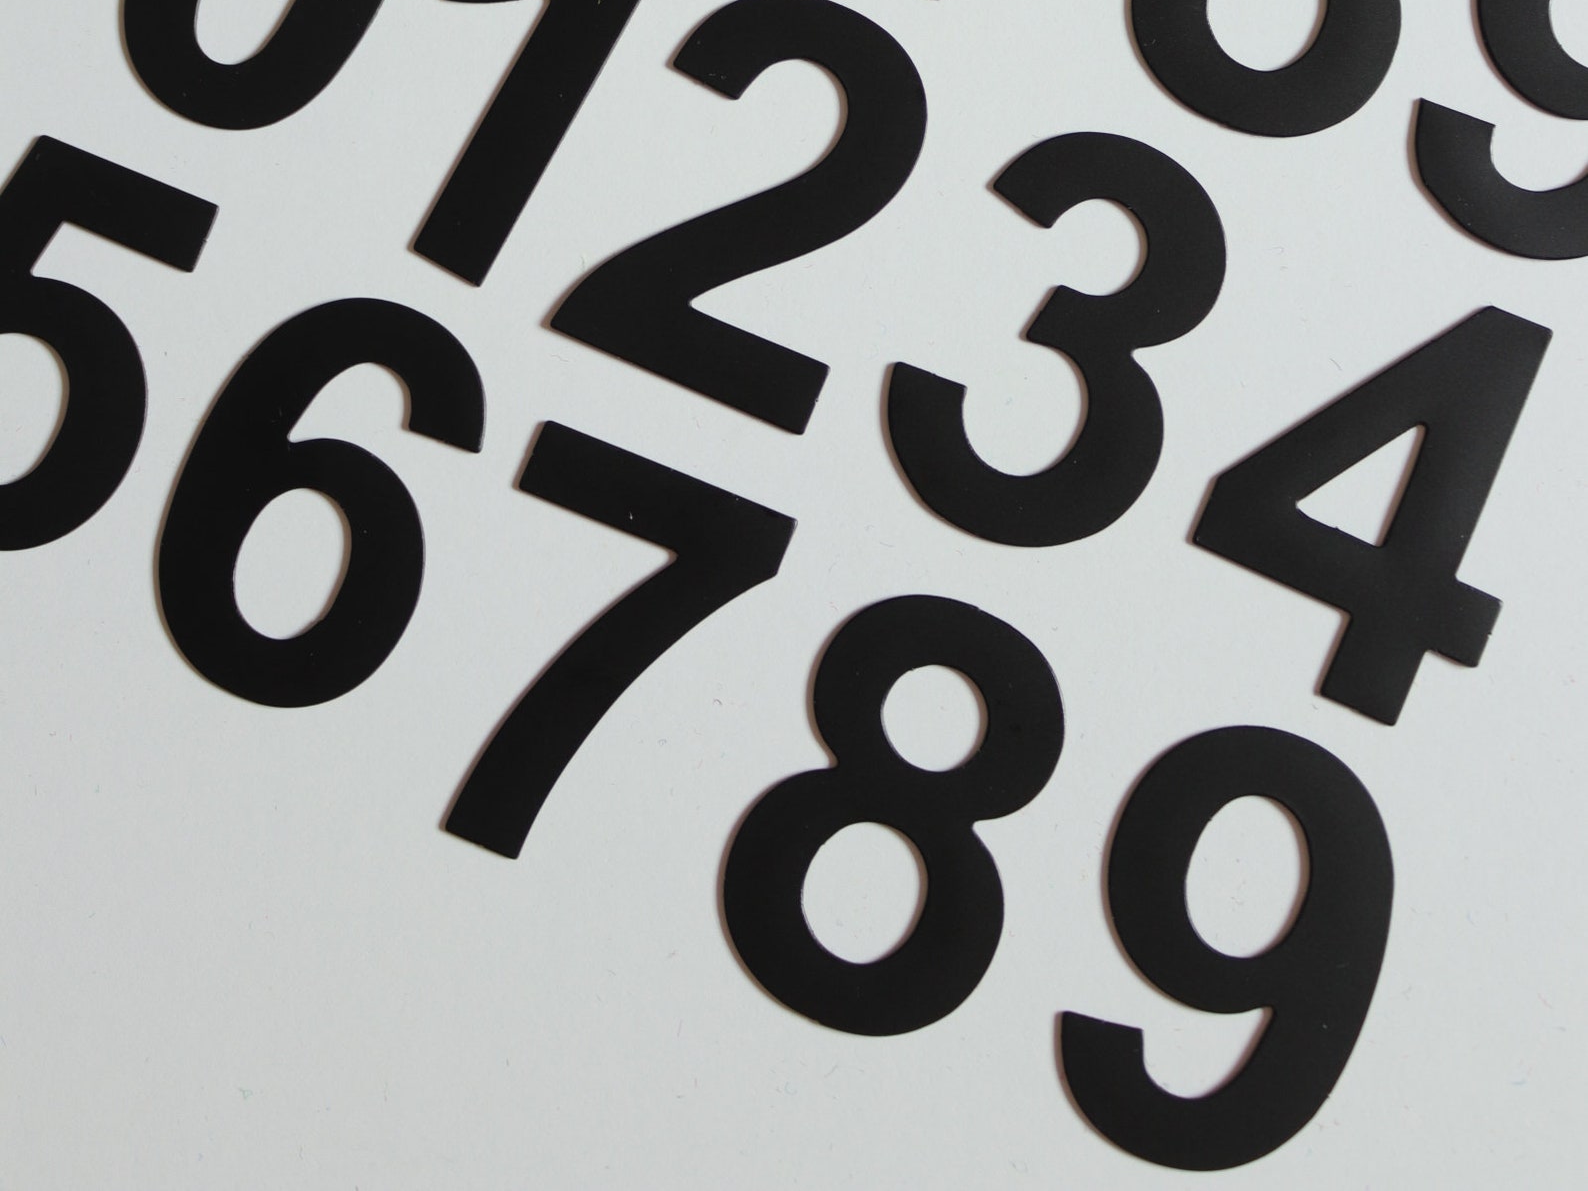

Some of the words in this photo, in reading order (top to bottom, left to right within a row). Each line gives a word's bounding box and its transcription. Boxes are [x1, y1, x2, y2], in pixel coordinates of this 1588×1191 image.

[0, 136, 217, 551] 5
[159, 298, 484, 707] 6
[445, 421, 794, 859] 7
[723, 595, 1064, 1036] 8
[1061, 726, 1392, 1171] 9
[887, 132, 1225, 547] 3
[1192, 306, 1550, 725] 4
